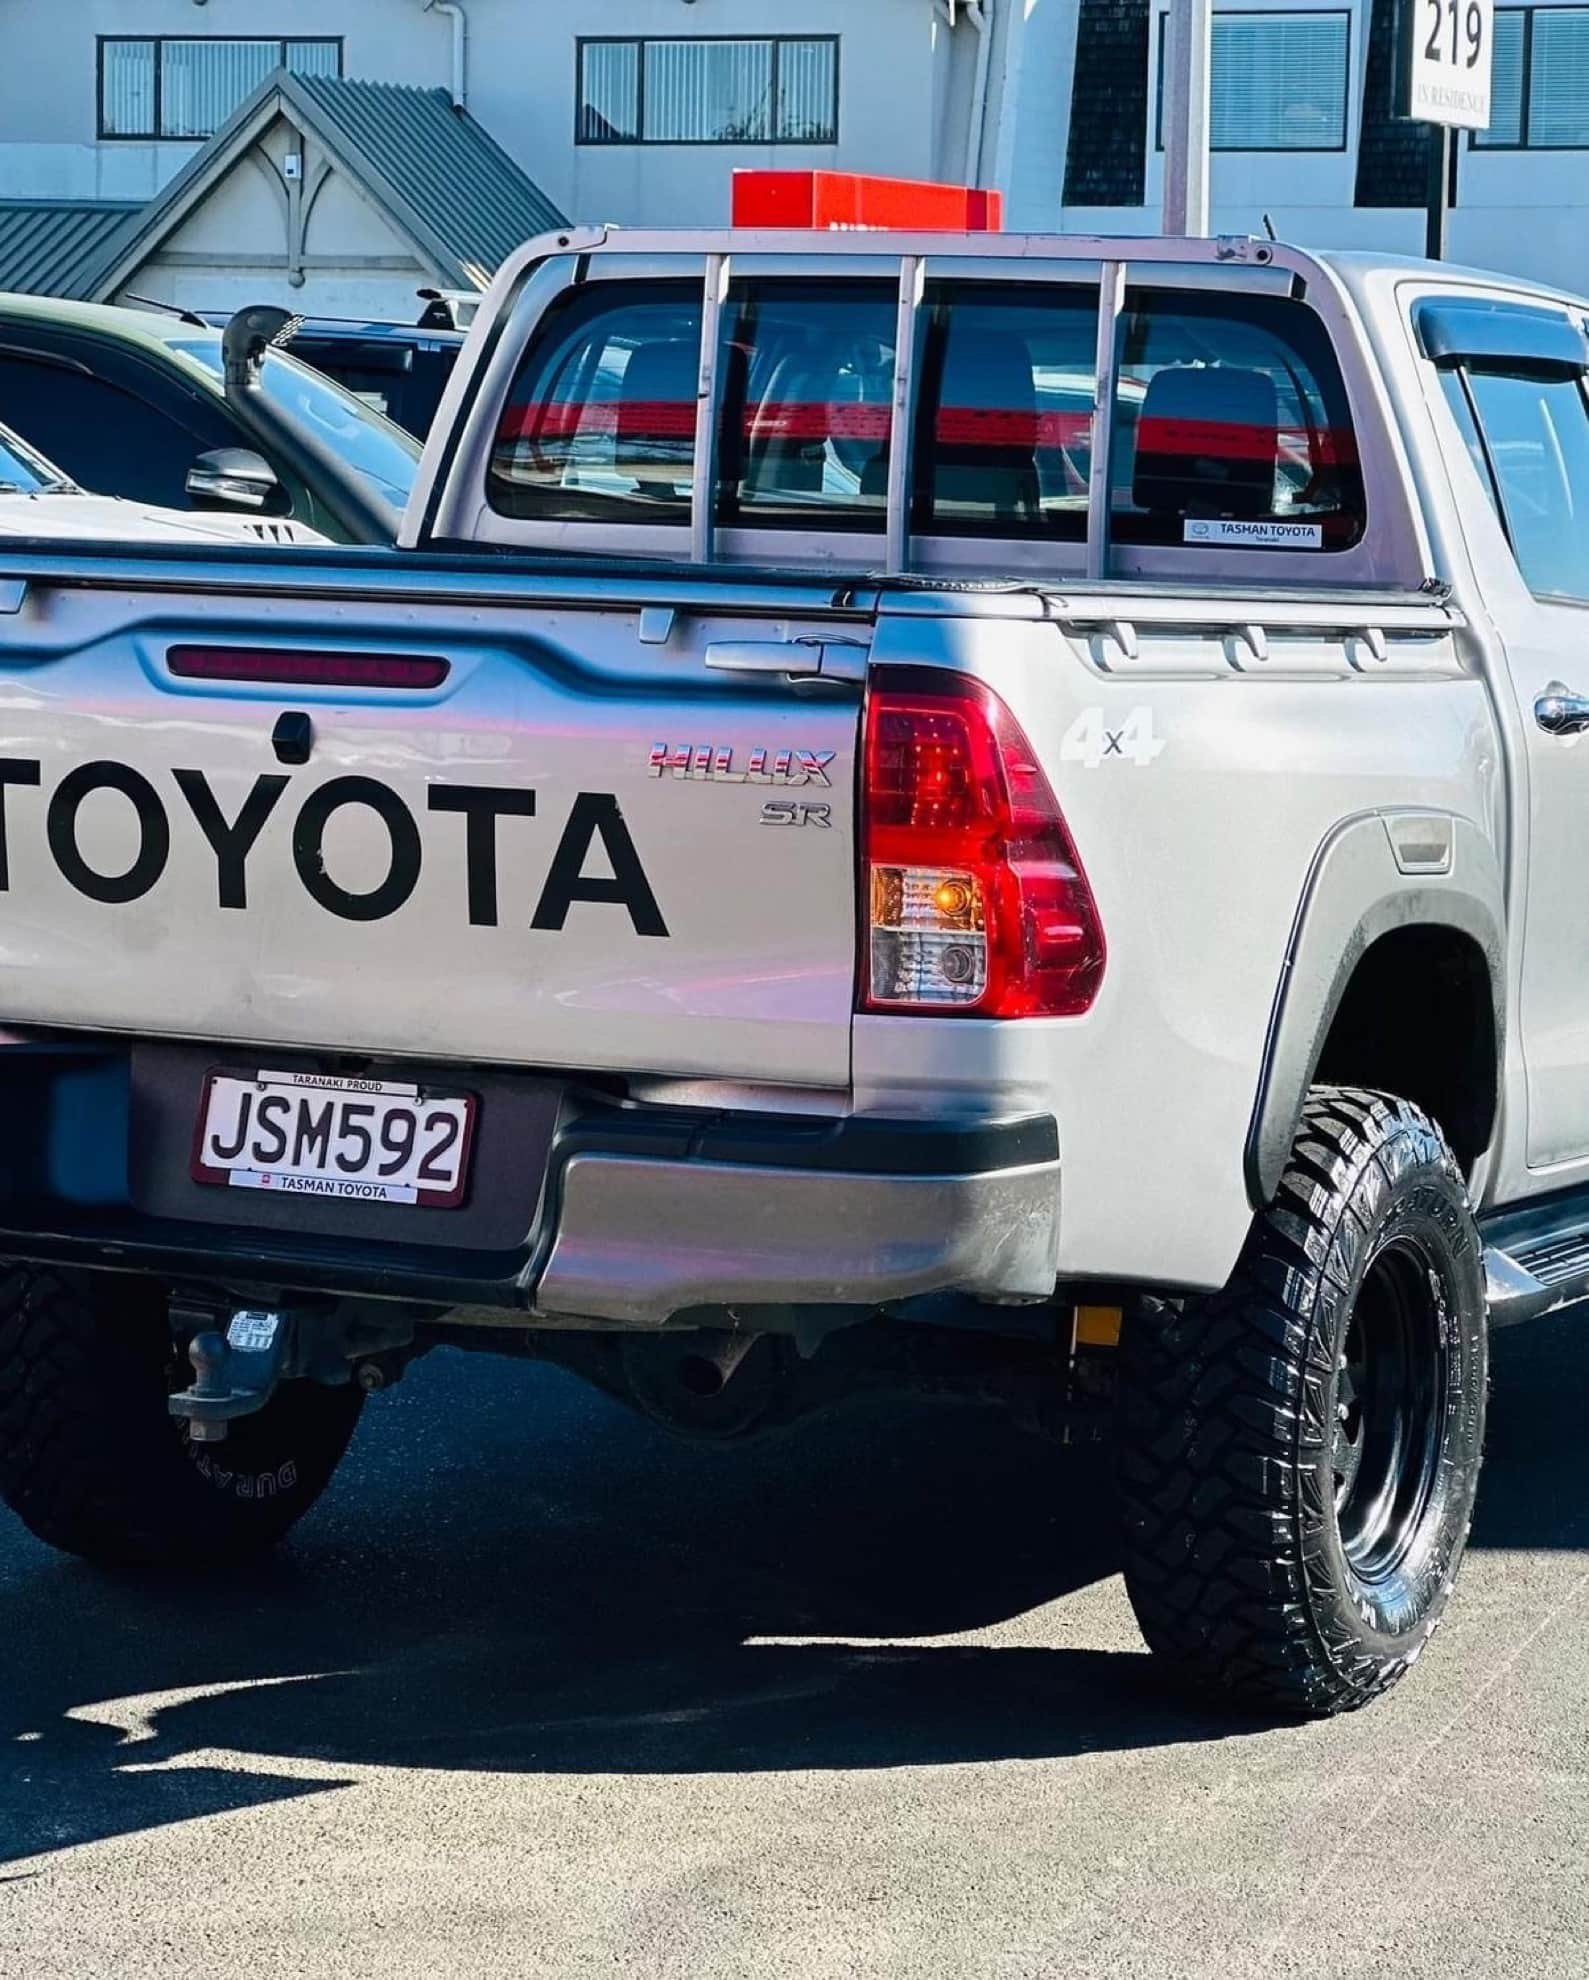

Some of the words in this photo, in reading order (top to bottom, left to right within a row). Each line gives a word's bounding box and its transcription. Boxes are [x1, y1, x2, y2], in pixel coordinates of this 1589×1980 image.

[1424, 0, 1481, 69] 219
[1271, 525, 1315, 537] TOYOTA
[649, 743, 836, 787] HILUX
[759, 800, 833, 829] SR
[293, 1074, 343, 1089] TARANAKI
[346, 1080, 383, 1092] PROUD
[211, 1093, 459, 1181] JSM592
[281, 1177, 334, 1194] TASMAN
[335, 1182, 387, 1199] TOYOTA
